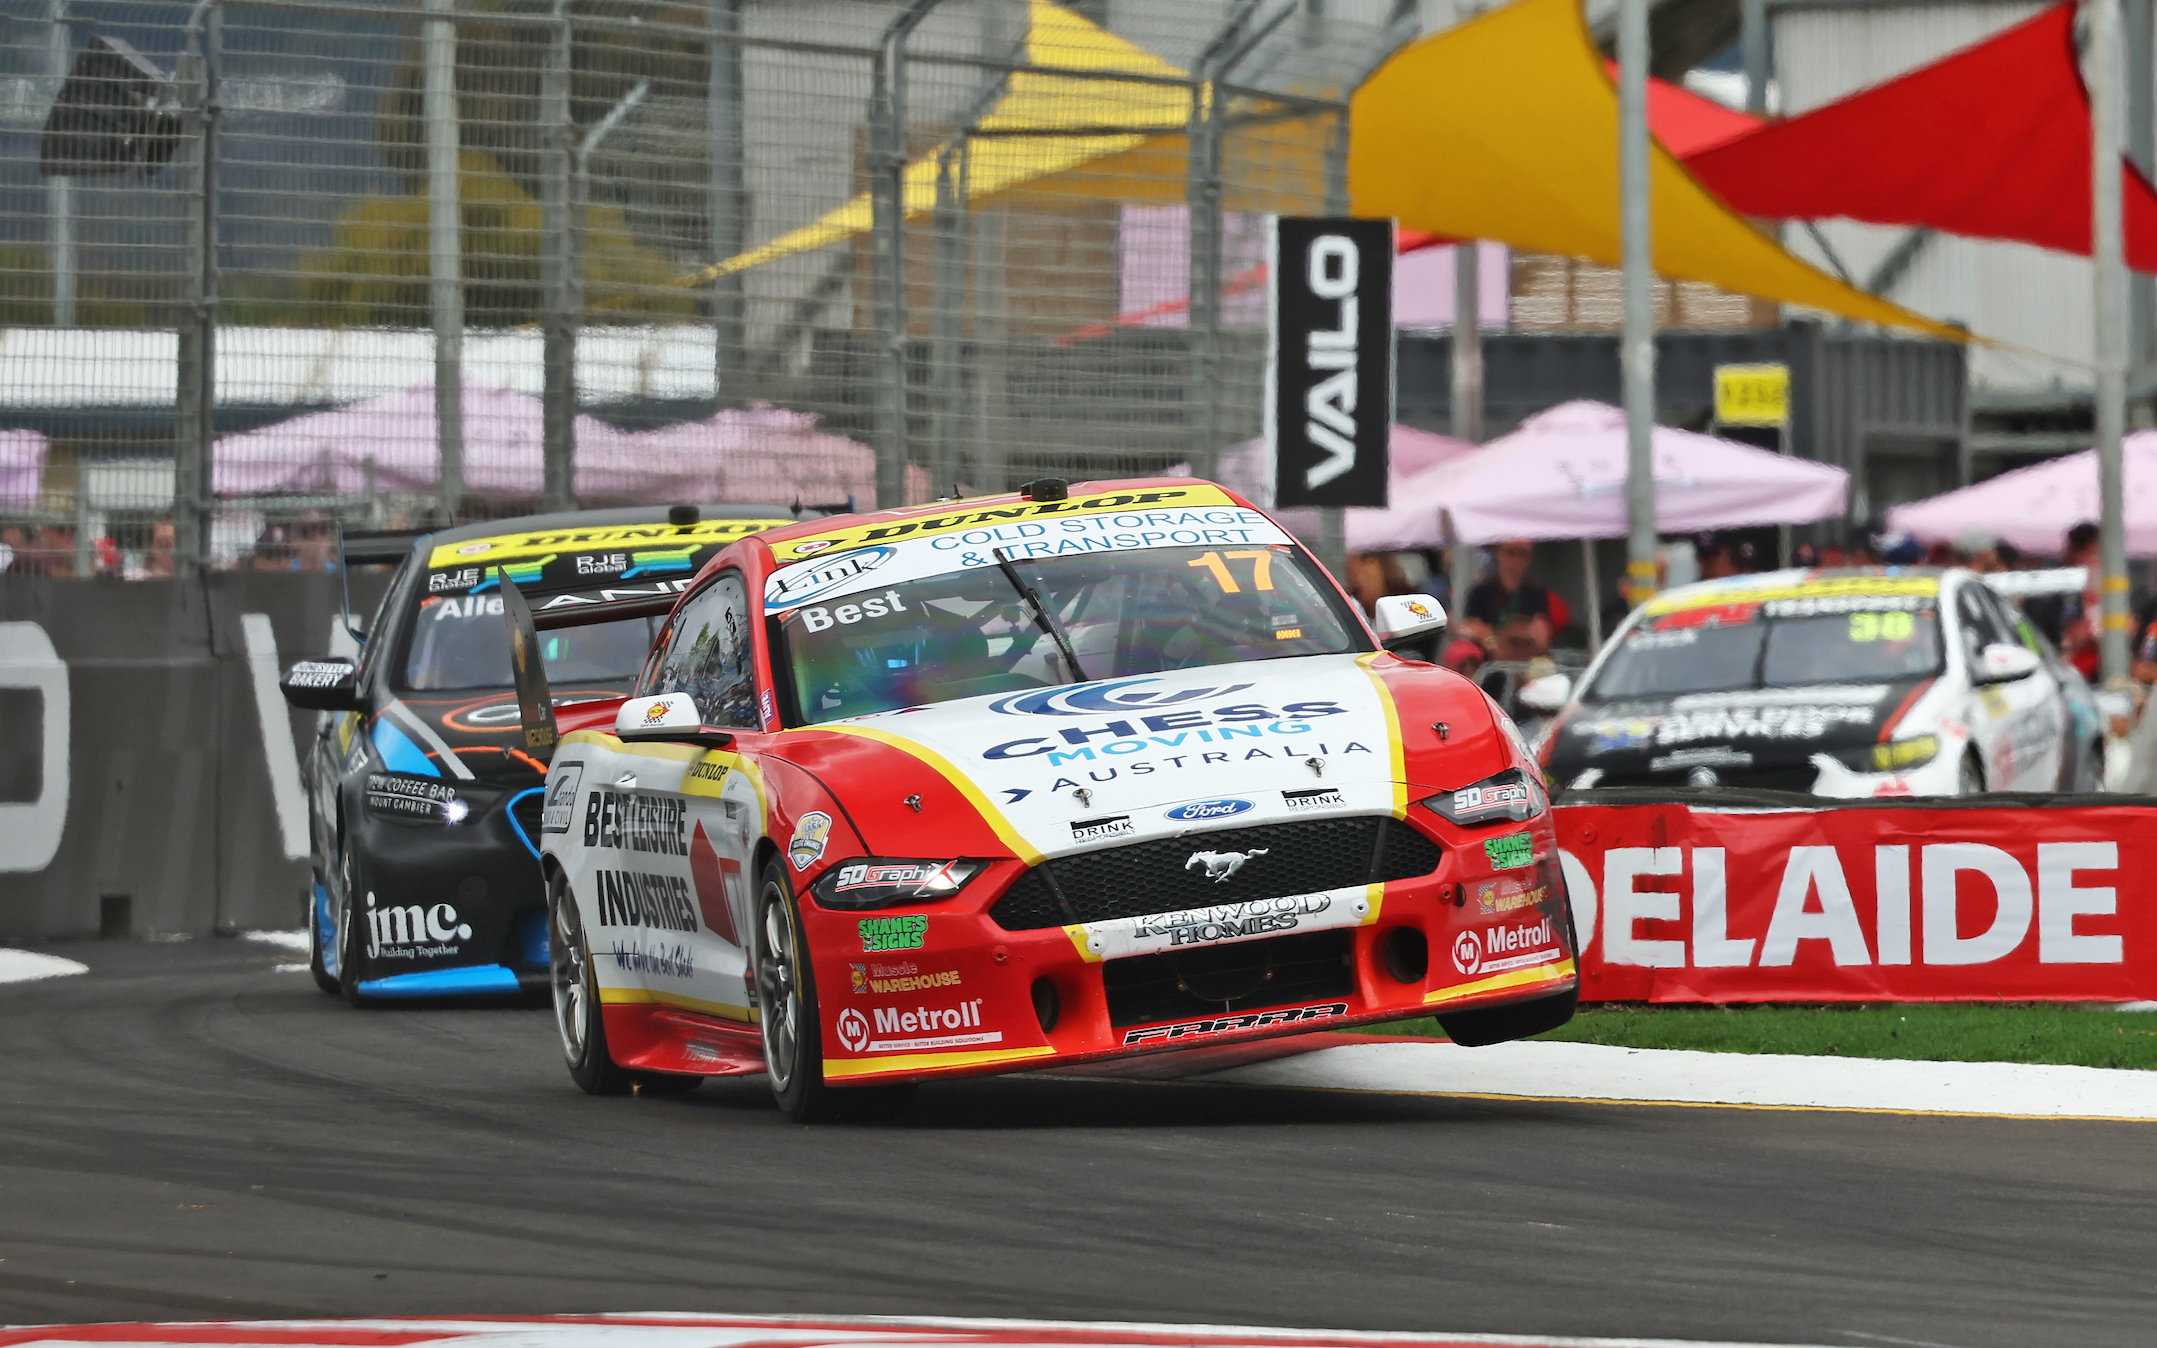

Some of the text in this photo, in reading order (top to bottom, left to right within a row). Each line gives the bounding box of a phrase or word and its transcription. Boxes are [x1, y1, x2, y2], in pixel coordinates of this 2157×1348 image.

[1306, 234, 1359, 490] VAILO
[858, 491, 1187, 543] DUNLOP
[523, 521, 768, 546] DUNLO
[931, 511, 1265, 550] COLD STORAGE
[961, 529, 1253, 567] & TRANSPORT
[576, 553, 627, 568] RJE
[577, 560, 627, 575] Global
[1187, 550, 1274, 594] 17
[429, 577, 478, 592] Global
[430, 568, 480, 585] RJE
[774, 558, 880, 594] Link
[435, 595, 505, 621] Alle
[801, 589, 907, 634] Best
[288, 672, 345, 687] BAKERY
[982, 701, 1349, 760] CHESS
[1047, 719, 1312, 766] MOVING
[691, 761, 729, 782] DUNLOP
[1051, 742, 1373, 792] AUSTRALIA
[386, 777, 429, 796] COFFEE
[430, 785, 456, 801] BAR
[1285, 794, 1345, 807] DRINK
[369, 796, 432, 815] MOUNT GAMBIER
[1183, 800, 1237, 819] Ford
[1288, 802, 1348, 812] RESPONSIBLY
[1072, 821, 1134, 839] DRINK
[1499, 849, 1535, 868] SIGNS
[596, 869, 698, 933] INDUSTRIES
[1133, 892, 1331, 938] KENWOOD
[1169, 912, 1299, 946] HOMES
[1487, 917, 1551, 954] Metroll
[380, 943, 459, 960] Building Together
[872, 932, 923, 951] SIGNS
[869, 969, 962, 993] WAREHOUSE
[870, 961, 918, 978] Muscle
[846, 1000, 981, 1037] M Metroll
[930, 1038, 954, 1046] BUILDING
[954, 1036, 984, 1044] SOLUTIONS
